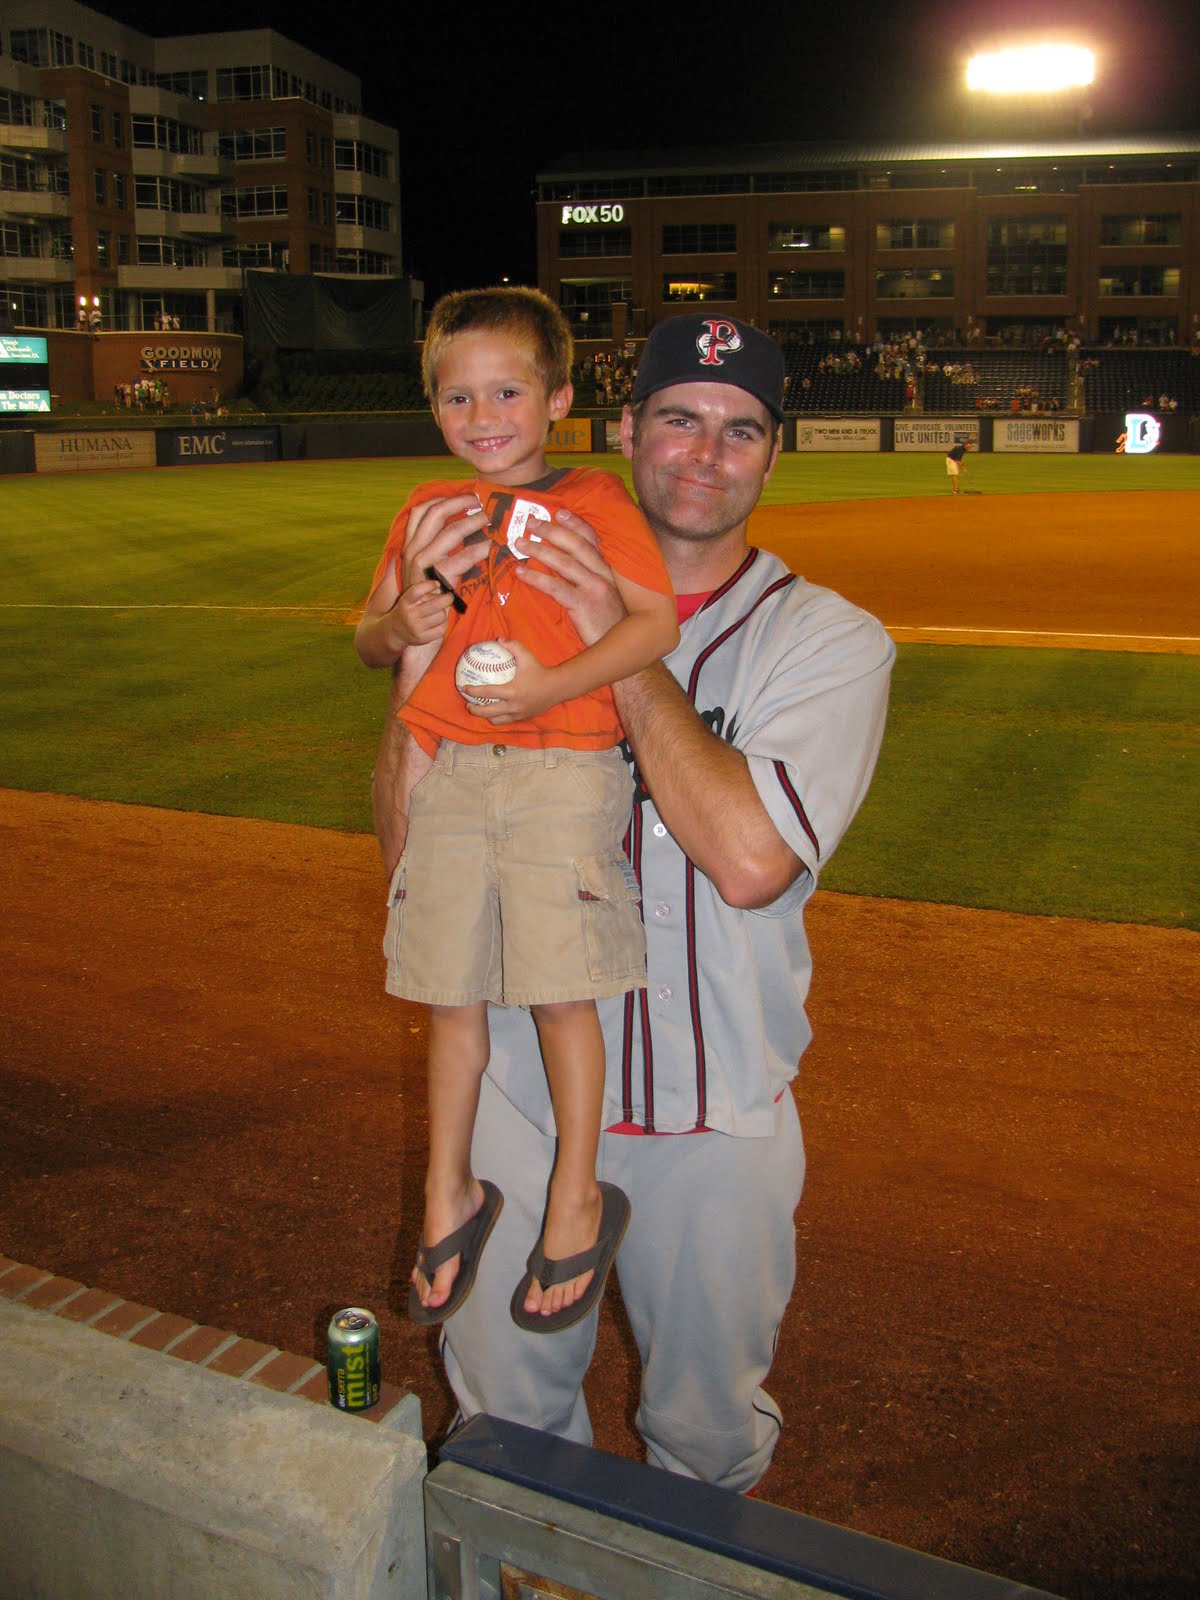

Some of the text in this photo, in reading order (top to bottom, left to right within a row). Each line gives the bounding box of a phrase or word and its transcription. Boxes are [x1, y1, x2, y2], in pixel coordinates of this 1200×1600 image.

[562, 204, 624, 224] FOX 50
[160, 360, 209, 368] FIELD
[8, 390, 41, 400] Doctors
[1, 400, 40, 410] The Bulls
[895, 431, 951, 443] LIVE UNITED
[1007, 422, 1065, 442] sageworks
[60, 437, 132, 453] HUMANA
[341, 1344, 365, 1407] mist
